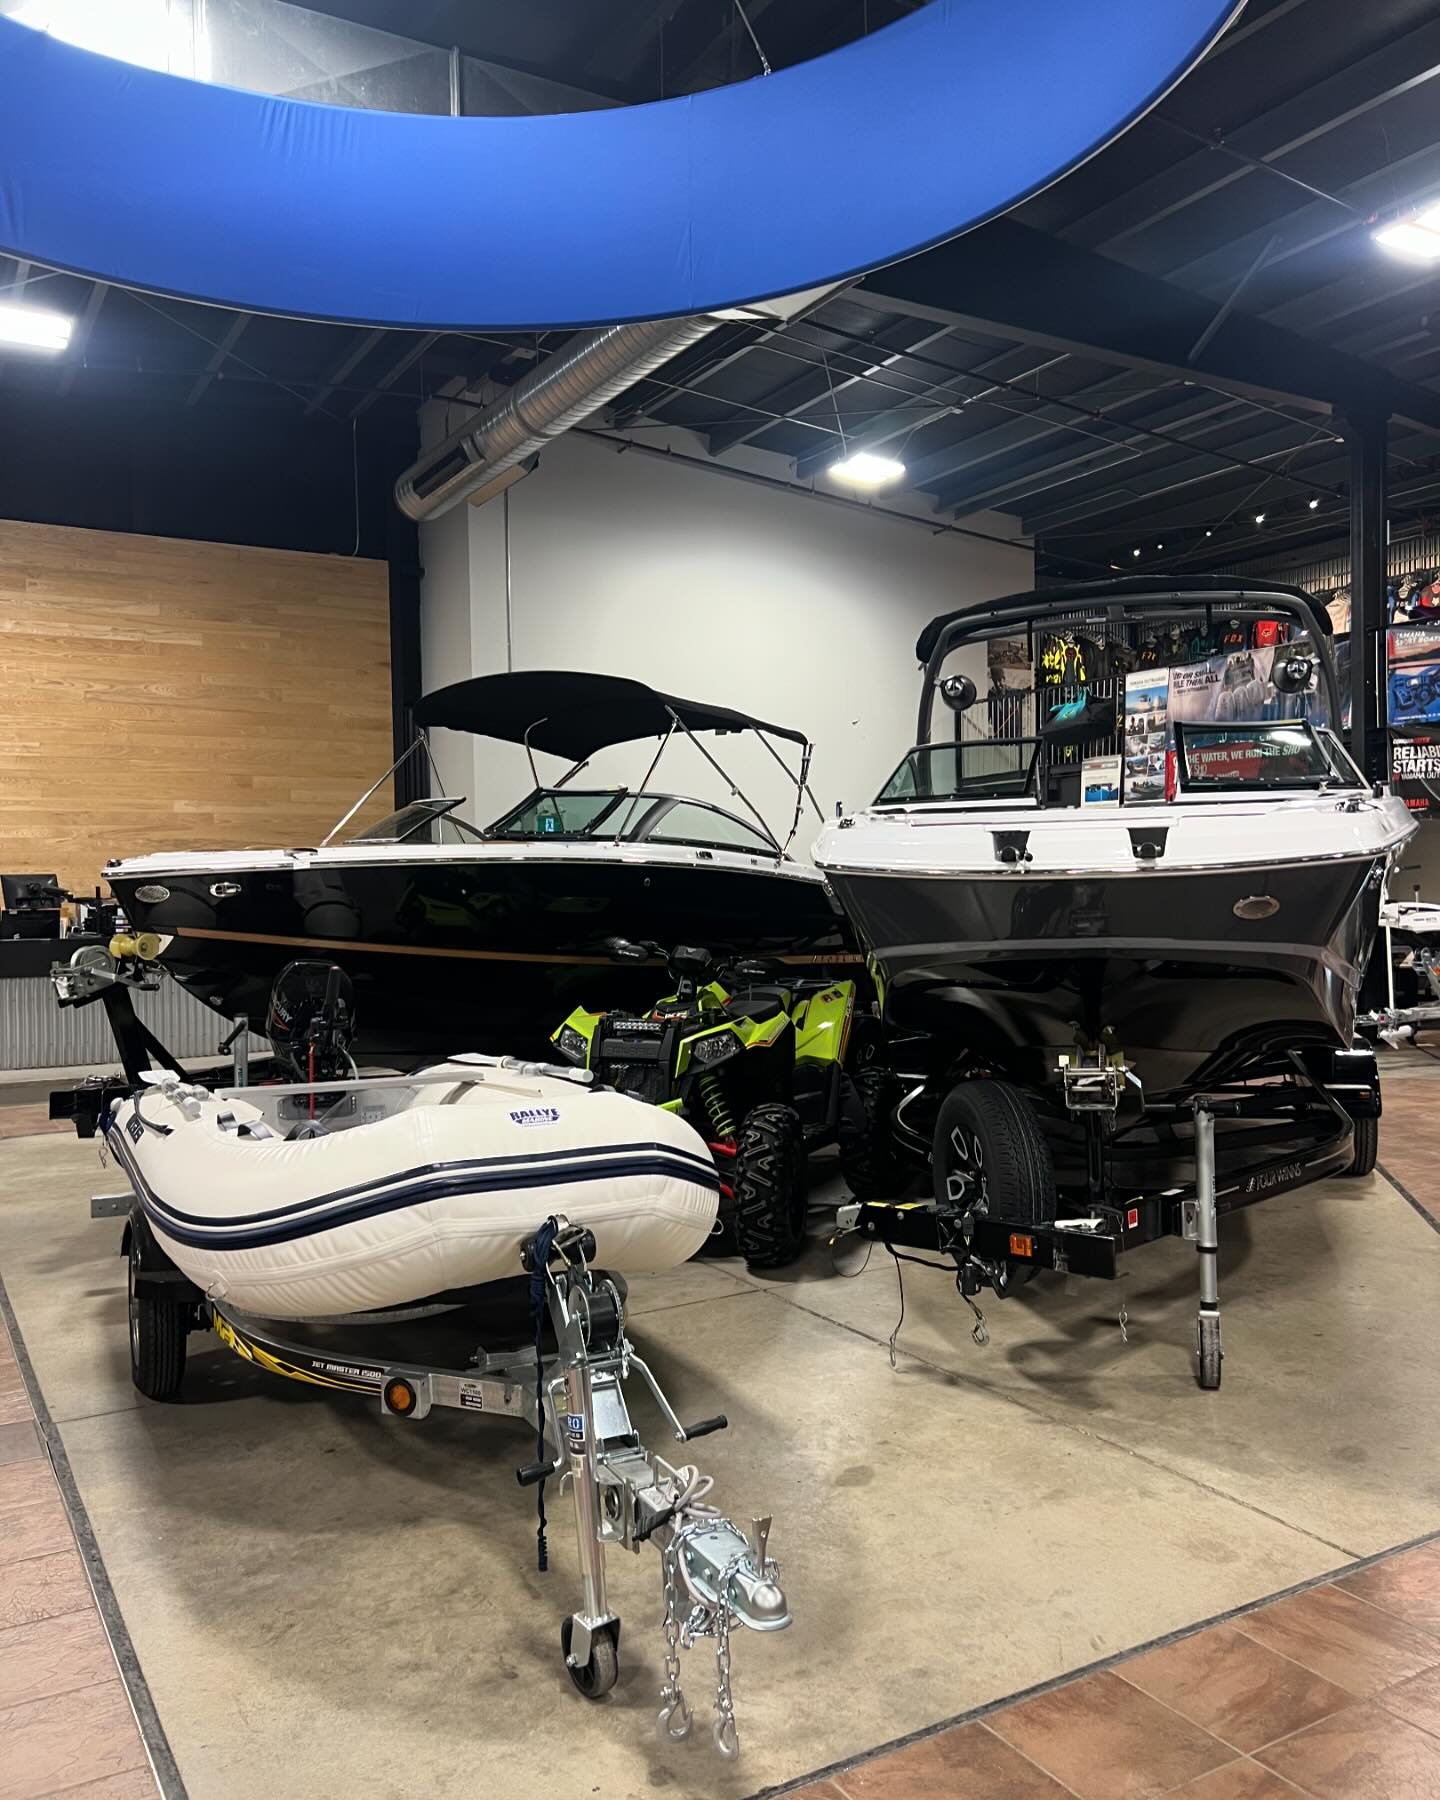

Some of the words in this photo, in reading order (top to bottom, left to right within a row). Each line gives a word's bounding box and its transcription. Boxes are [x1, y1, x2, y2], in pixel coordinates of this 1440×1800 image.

[1223, 633, 1244, 644] FOX
[1205, 673, 1221, 684] ALL
[1231, 750, 1244, 760] WE
[1393, 758, 1440, 774] STARTS
[1401, 771, 1425, 780] YAMAHA
[510, 1108, 559, 1121] RALLYE
[312, 1360, 325, 1369] JET
[326, 1363, 360, 1375] MASTER
